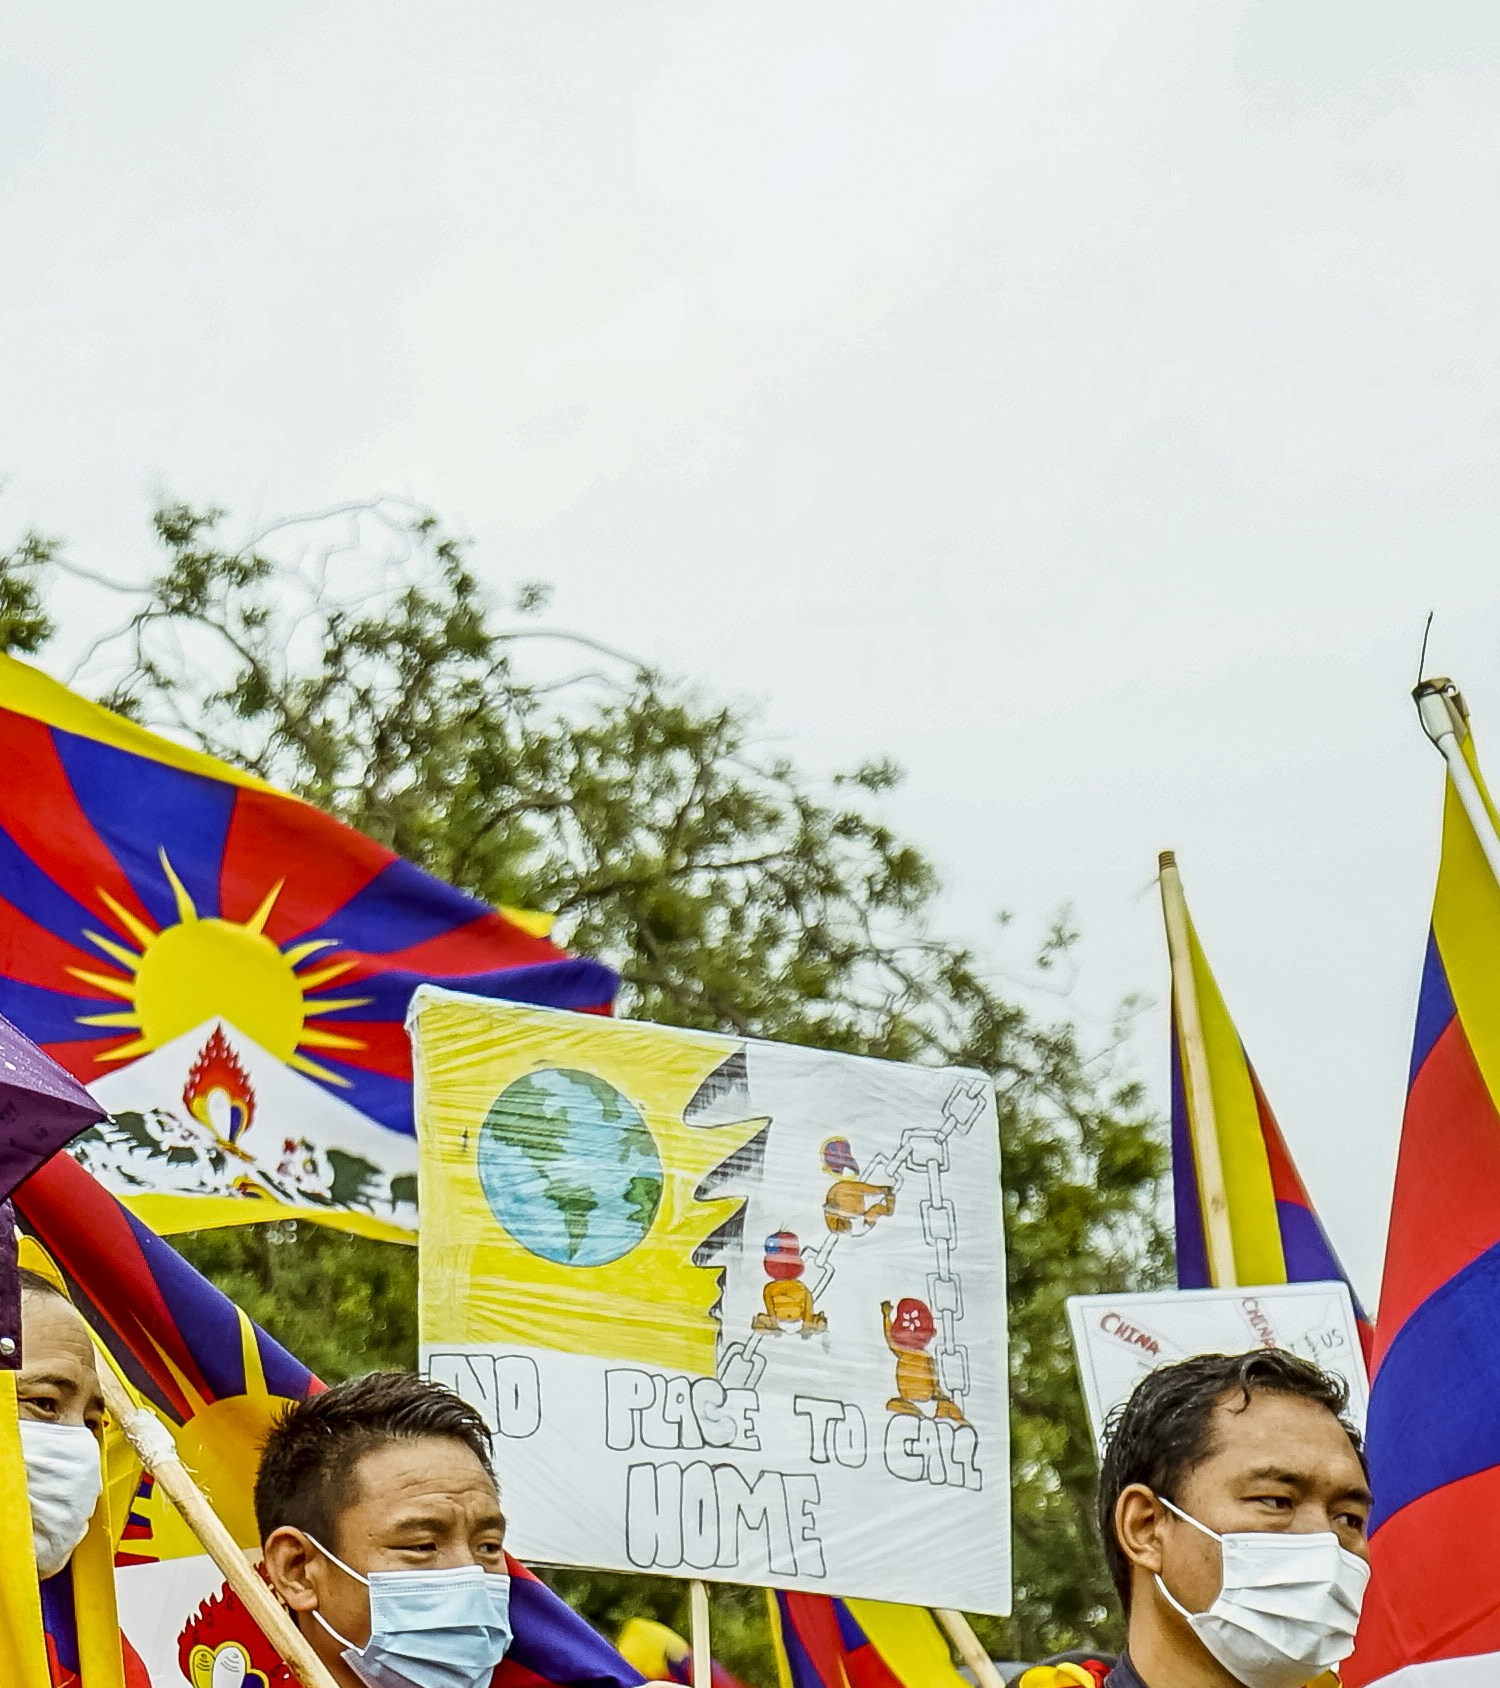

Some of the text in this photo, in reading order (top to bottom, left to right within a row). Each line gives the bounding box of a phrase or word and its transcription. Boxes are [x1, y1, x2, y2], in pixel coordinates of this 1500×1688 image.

[1100, 1311, 1159, 1356] CHINA
[428, 1353, 983, 1491] NO PLACE TO CALL
[626, 1461, 826, 1578] HOME
